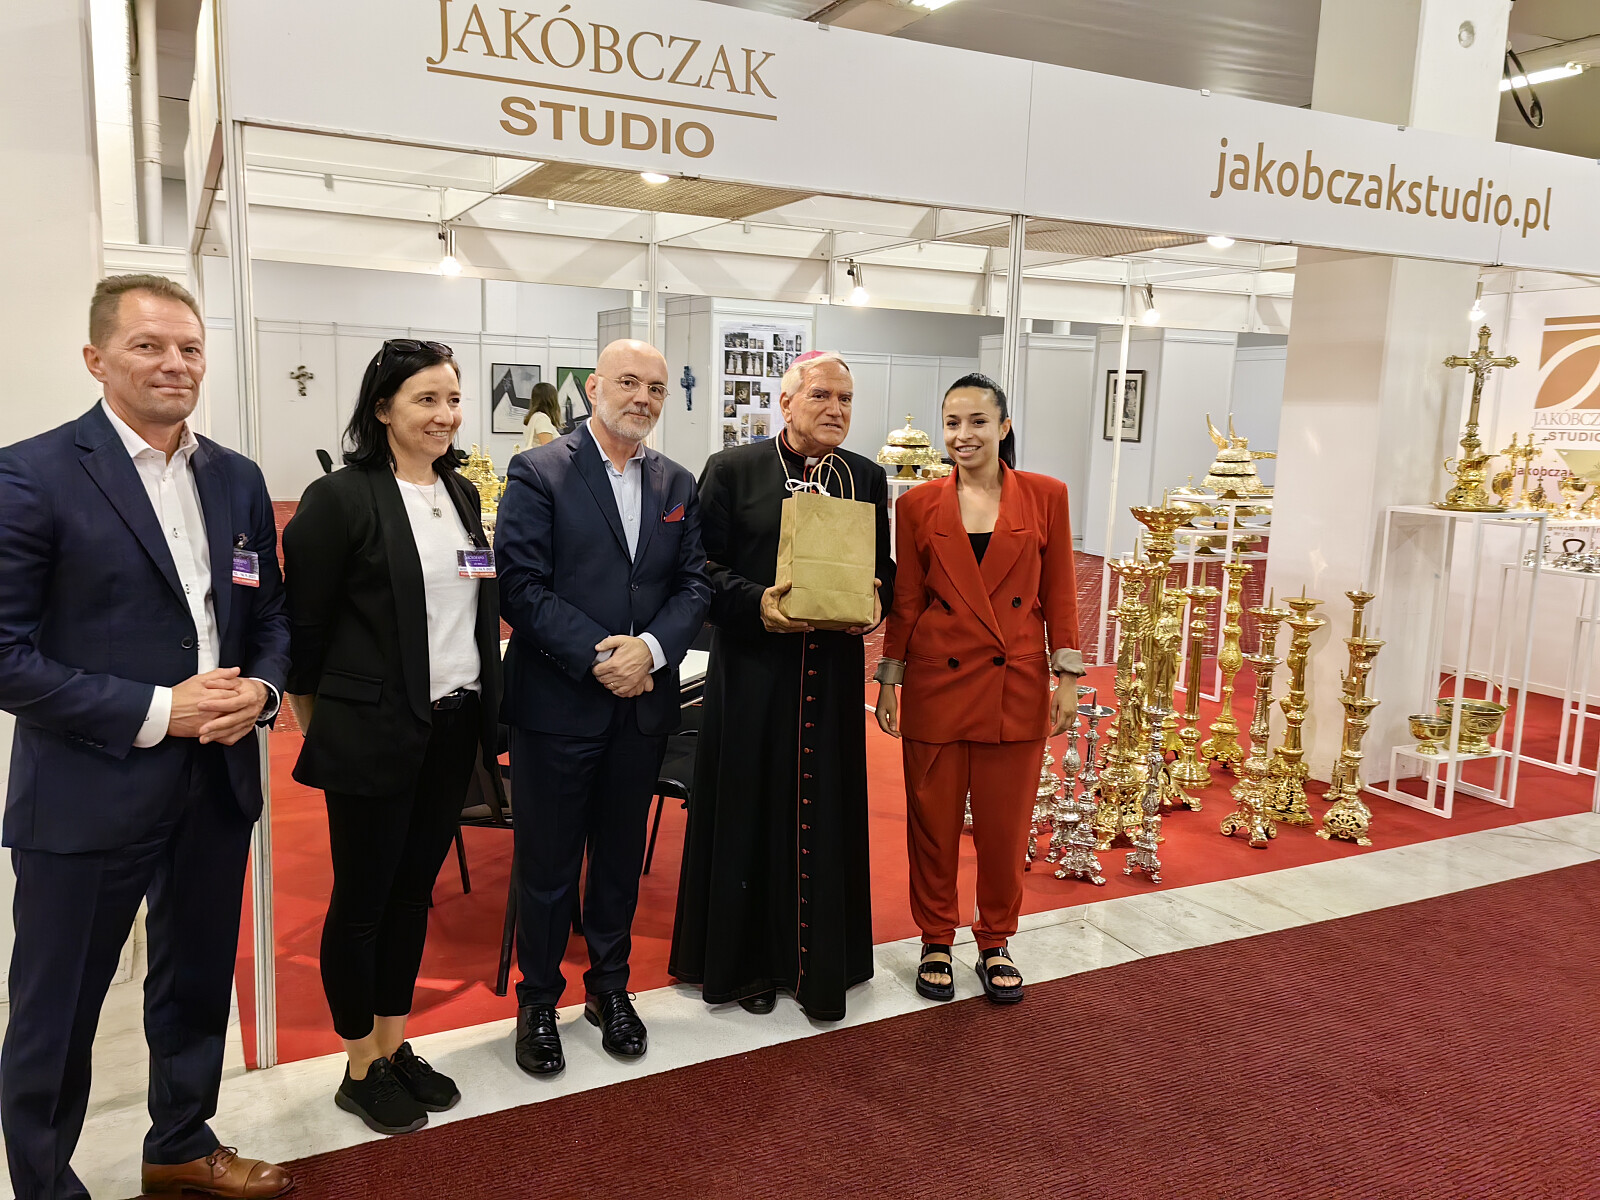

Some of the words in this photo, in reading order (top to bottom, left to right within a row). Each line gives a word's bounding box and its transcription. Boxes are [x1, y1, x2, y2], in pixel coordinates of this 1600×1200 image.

[426, 0, 778, 99] JAKÓBCZAK
[499, 96, 715, 158] STUDIO
[1210, 137, 1552, 238] jakobczakstudio.pl
